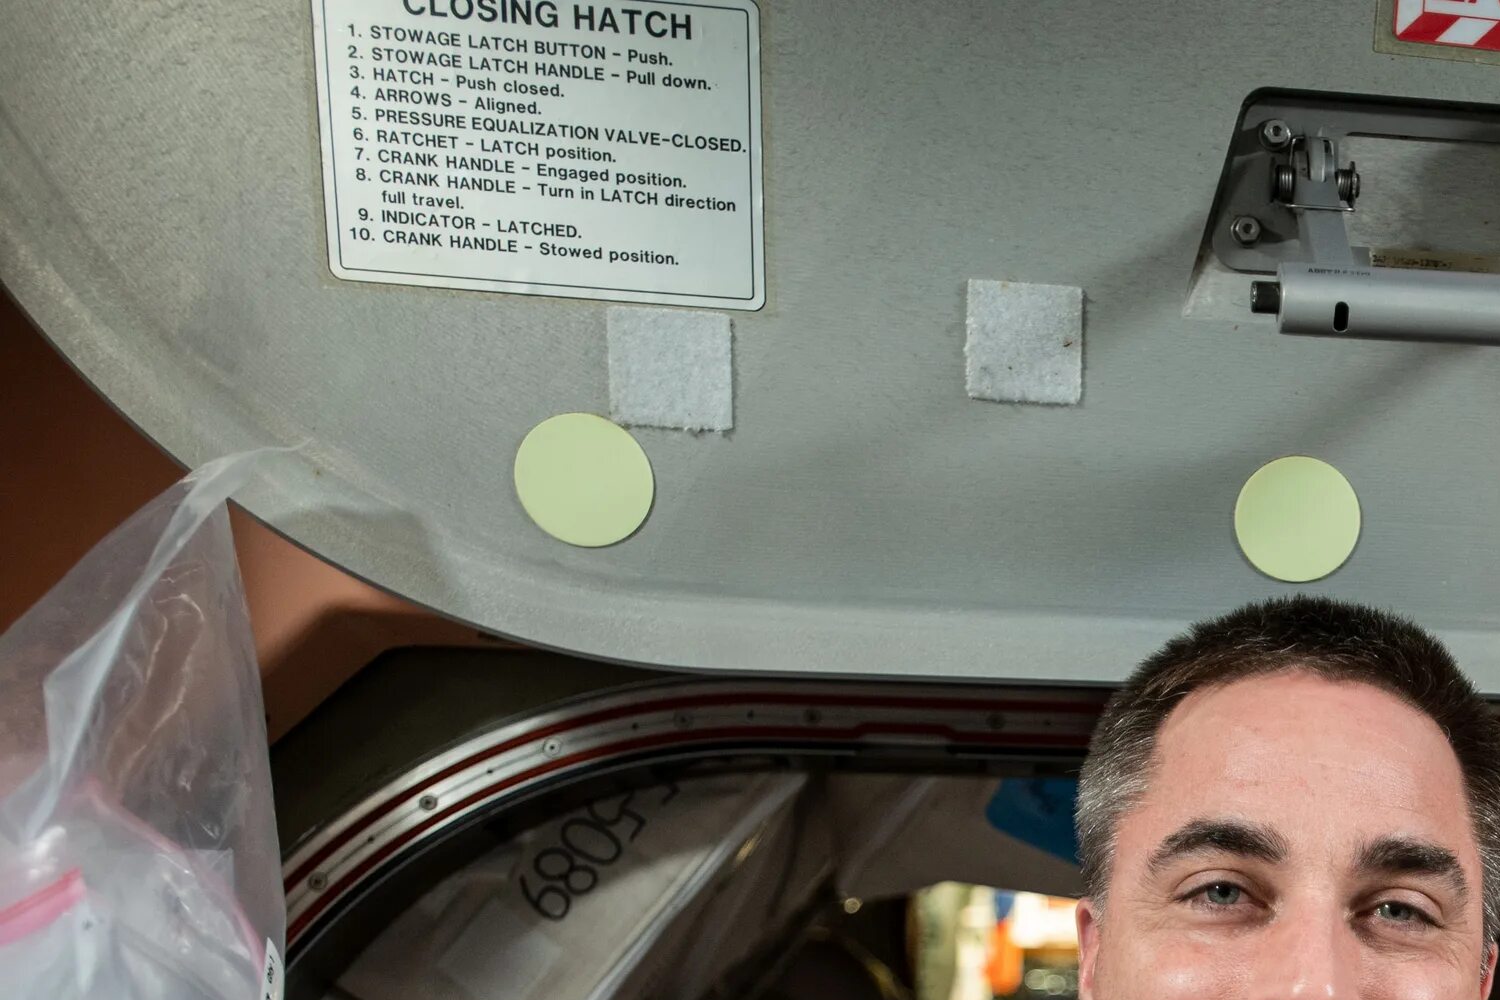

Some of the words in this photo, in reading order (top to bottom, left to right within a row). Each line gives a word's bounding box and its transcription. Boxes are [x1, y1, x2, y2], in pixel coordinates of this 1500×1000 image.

[402, 0, 559, 28] CLOSING
[573, 4, 692, 40] HATCH
[348, 23, 362, 38] 1.
[370, 25, 461, 47] STOWAGE
[468, 34, 528, 53] LATCH
[534, 40, 606, 60] BUTTON
[628, 49, 673, 66] Push.
[347, 45, 363, 59] 2.
[372, 47, 462, 68] STOWAGE
[469, 56, 528, 74] LATCH
[535, 62, 605, 81] HANDLE
[626, 70, 655, 86] Pull
[662, 73, 711, 91] down.
[349, 65, 365, 80] 3.
[373, 67, 434, 86] HATCH
[456, 74, 496, 91] Push
[503, 80, 564, 97] closed.
[350, 85, 366, 100] 4.
[375, 87, 452, 107] ARROWS
[474, 96, 542, 115] Aligned.
[352, 106, 367, 120] 5.
[375, 108, 467, 129] PRESSURE
[471, 117, 599, 141] EQUALIZATION
[353, 127, 369, 141] 6.
[376, 129, 459, 149] RATCHET
[481, 138, 539, 156] LATCH
[546, 146, 616, 163] position.
[354, 147, 370, 161] 7.
[378, 149, 439, 167] CRANK
[446, 155, 515, 174] HANDLE
[537, 163, 609, 183] Engaged
[616, 172, 687, 188] position.
[356, 168, 371, 181] 8.
[379, 169, 440, 187] CRANK
[447, 175, 516, 194] HANDLE
[537, 183, 574, 199] Turn
[581, 186, 594, 200] in
[601, 188, 658, 206] LATCH
[664, 194, 736, 212] direction
[381, 190, 406, 205] full
[412, 193, 464, 210] travel.
[358, 208, 374, 222] 9.
[381, 209, 476, 230] INDICATOR
[497, 219, 582, 239] LATCHED.
[349, 227, 375, 241] 10.
[383, 229, 443, 247] CRANK
[449, 235, 518, 253] HANDLE
[539, 242, 603, 260] Stowed
[609, 250, 679, 266] position.
